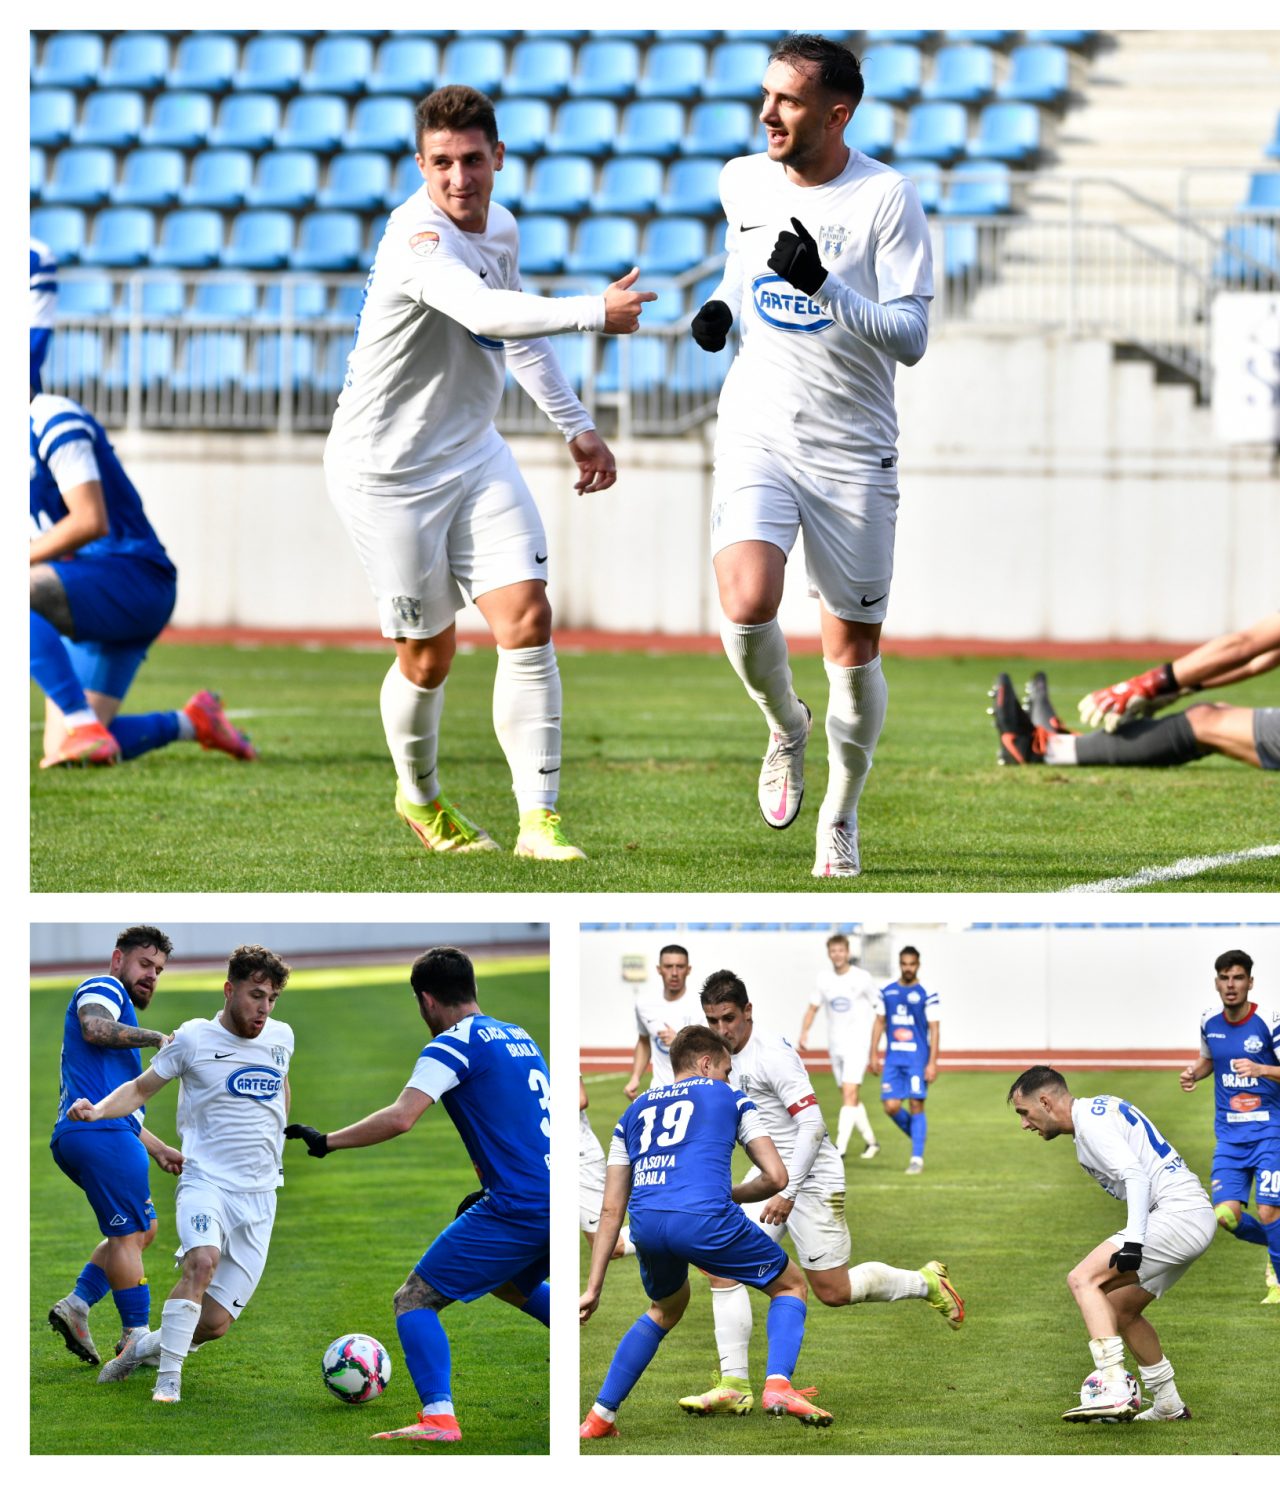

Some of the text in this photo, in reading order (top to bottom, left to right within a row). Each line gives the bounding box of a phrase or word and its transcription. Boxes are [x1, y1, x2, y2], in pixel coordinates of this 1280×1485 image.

[760, 291, 826, 315] ARTEG
[506, 1043, 540, 1057] BRAILA
[1222, 1073, 1259, 1088] BRAILA
[648, 1087, 689, 1101] BRAILA
[528, 1069, 550, 1138] 3
[638, 1100, 695, 1154] 19
[634, 1155, 675, 1174] BLASOVA
[634, 1171, 666, 1186] BRAILA
